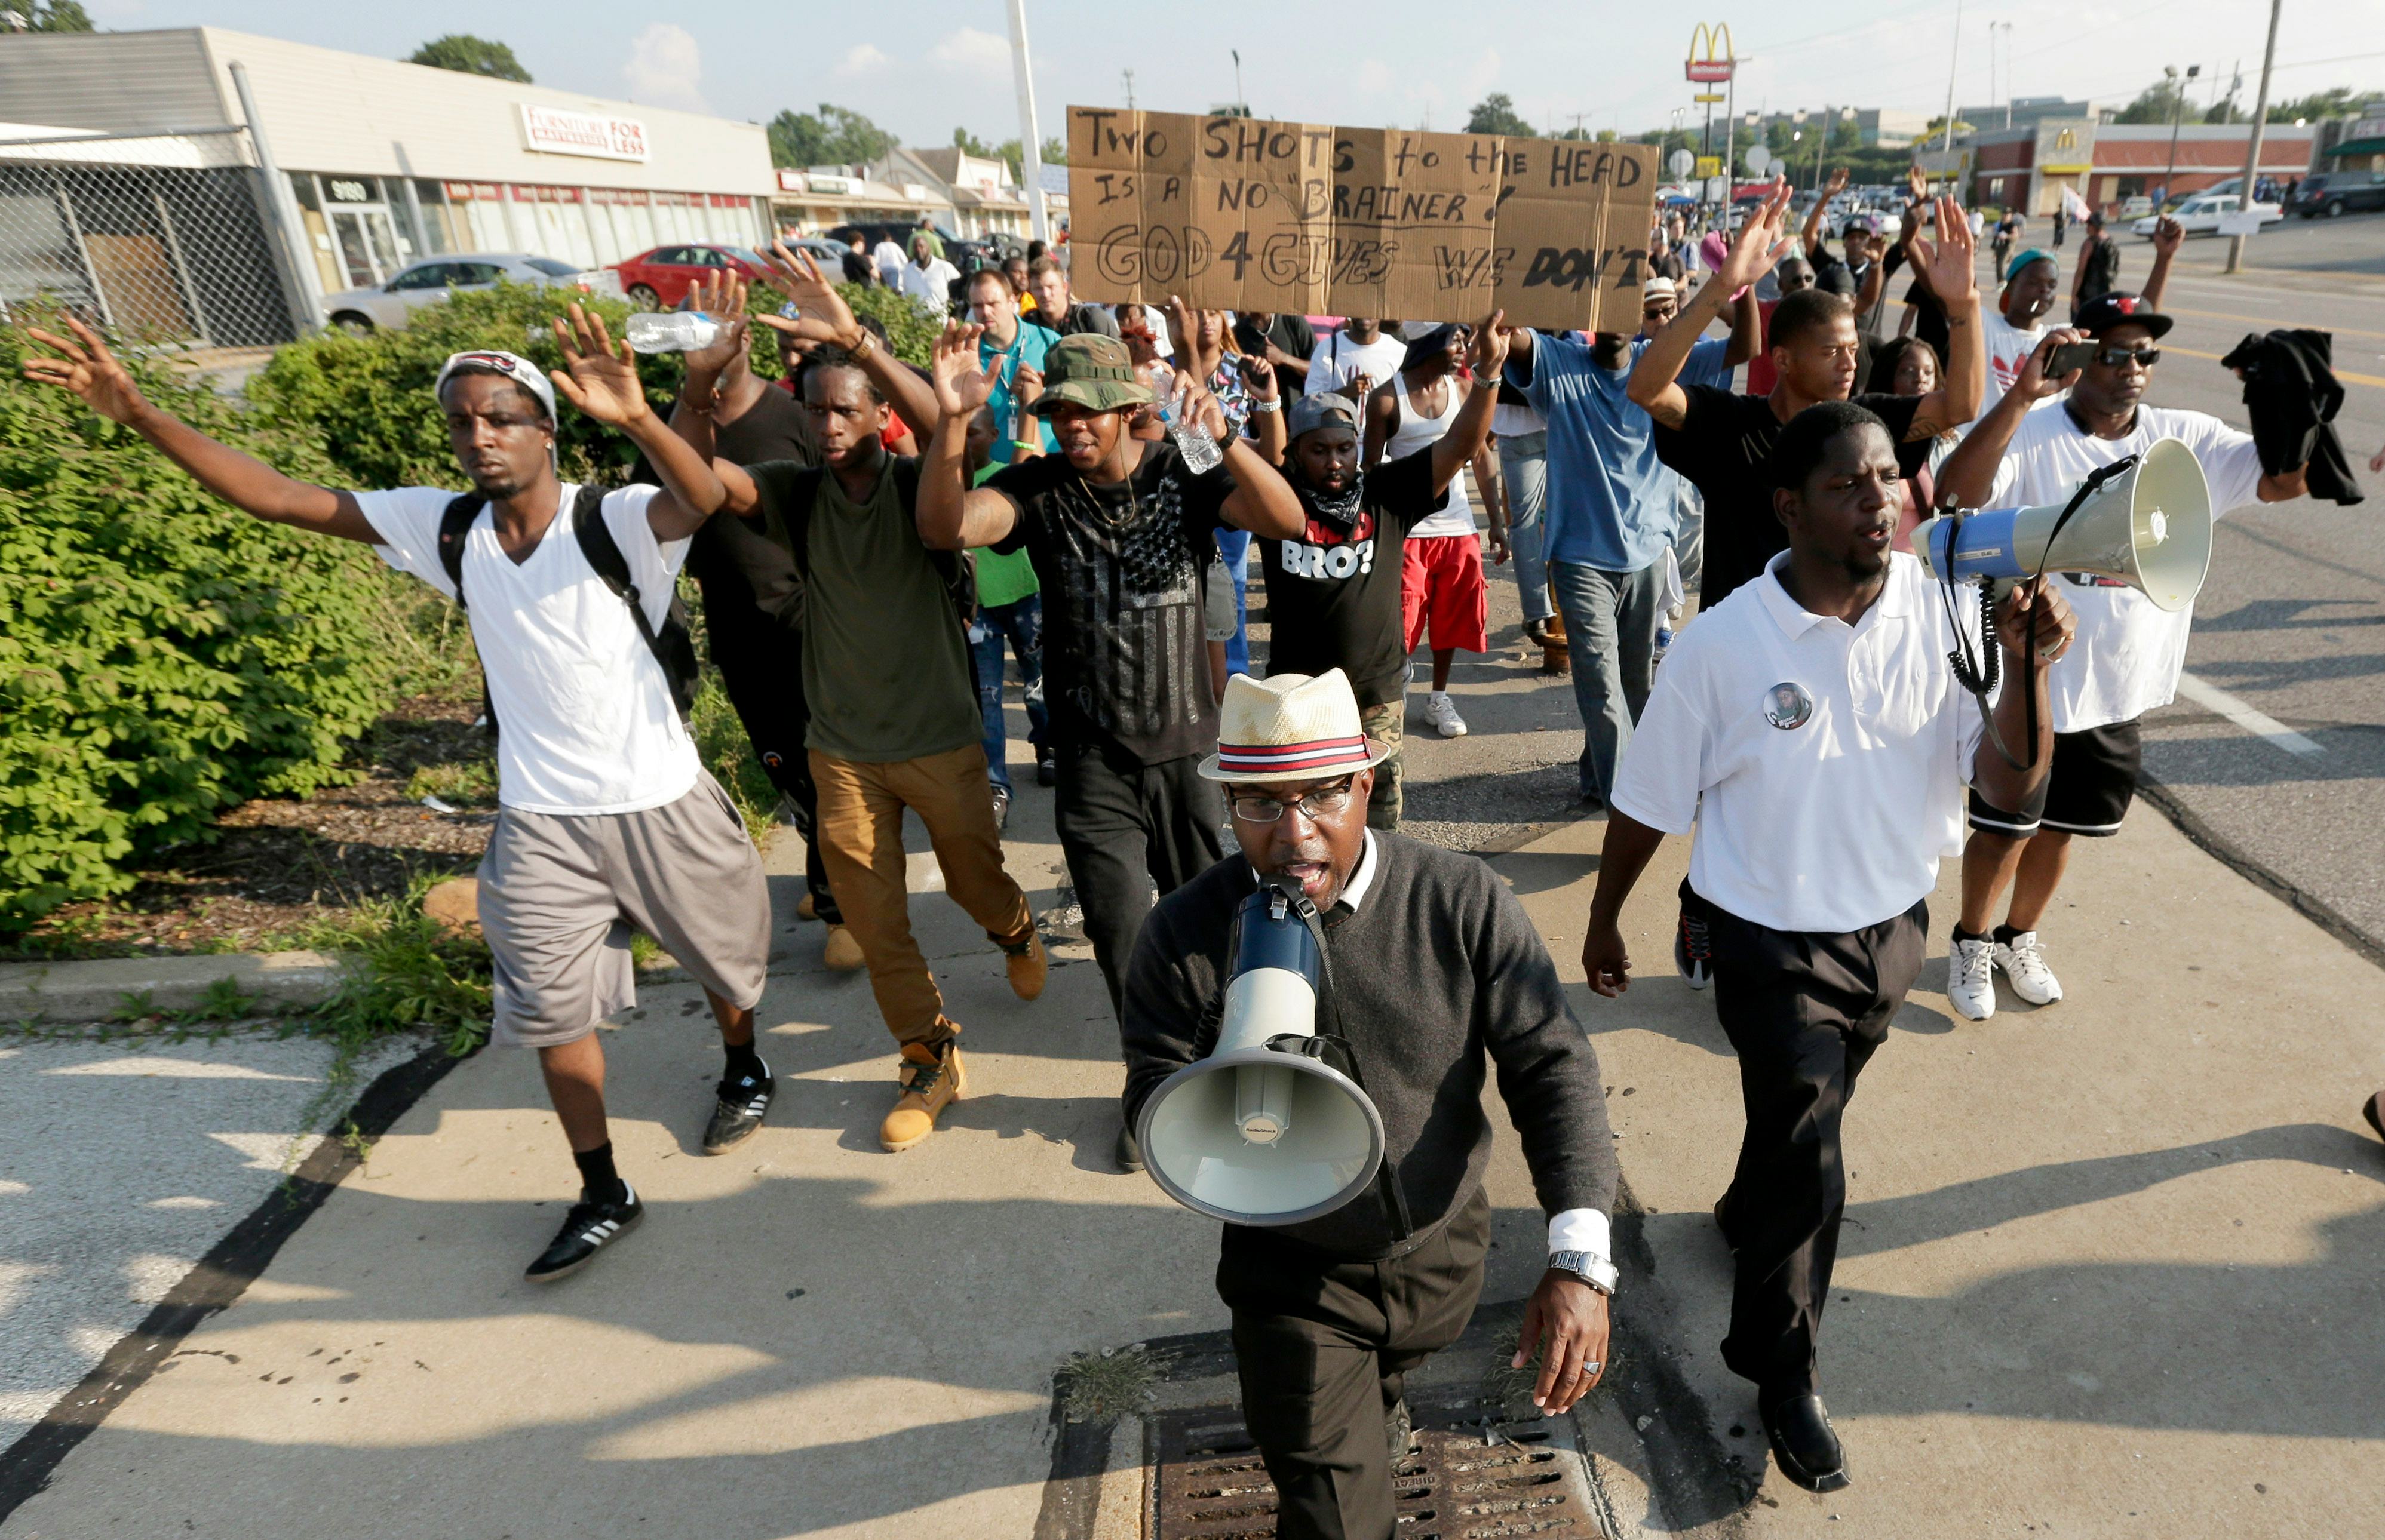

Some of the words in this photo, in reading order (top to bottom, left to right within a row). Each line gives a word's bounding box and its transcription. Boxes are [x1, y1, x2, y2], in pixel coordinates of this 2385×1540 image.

[610, 121, 641, 139] FOR
[613, 137, 644, 154] LESS
[1204, 118, 1355, 173] SHOTS
[1394, 137, 1439, 177] to
[1549, 145, 1641, 188] HEAD
[1162, 177, 1180, 202] A
[1217, 179, 1268, 212] NO
[1097, 223, 1213, 286] GOD
[1434, 245, 1516, 291] WE
[1522, 244, 1647, 293] DON'T
[1281, 539, 1374, 579] BRO?
